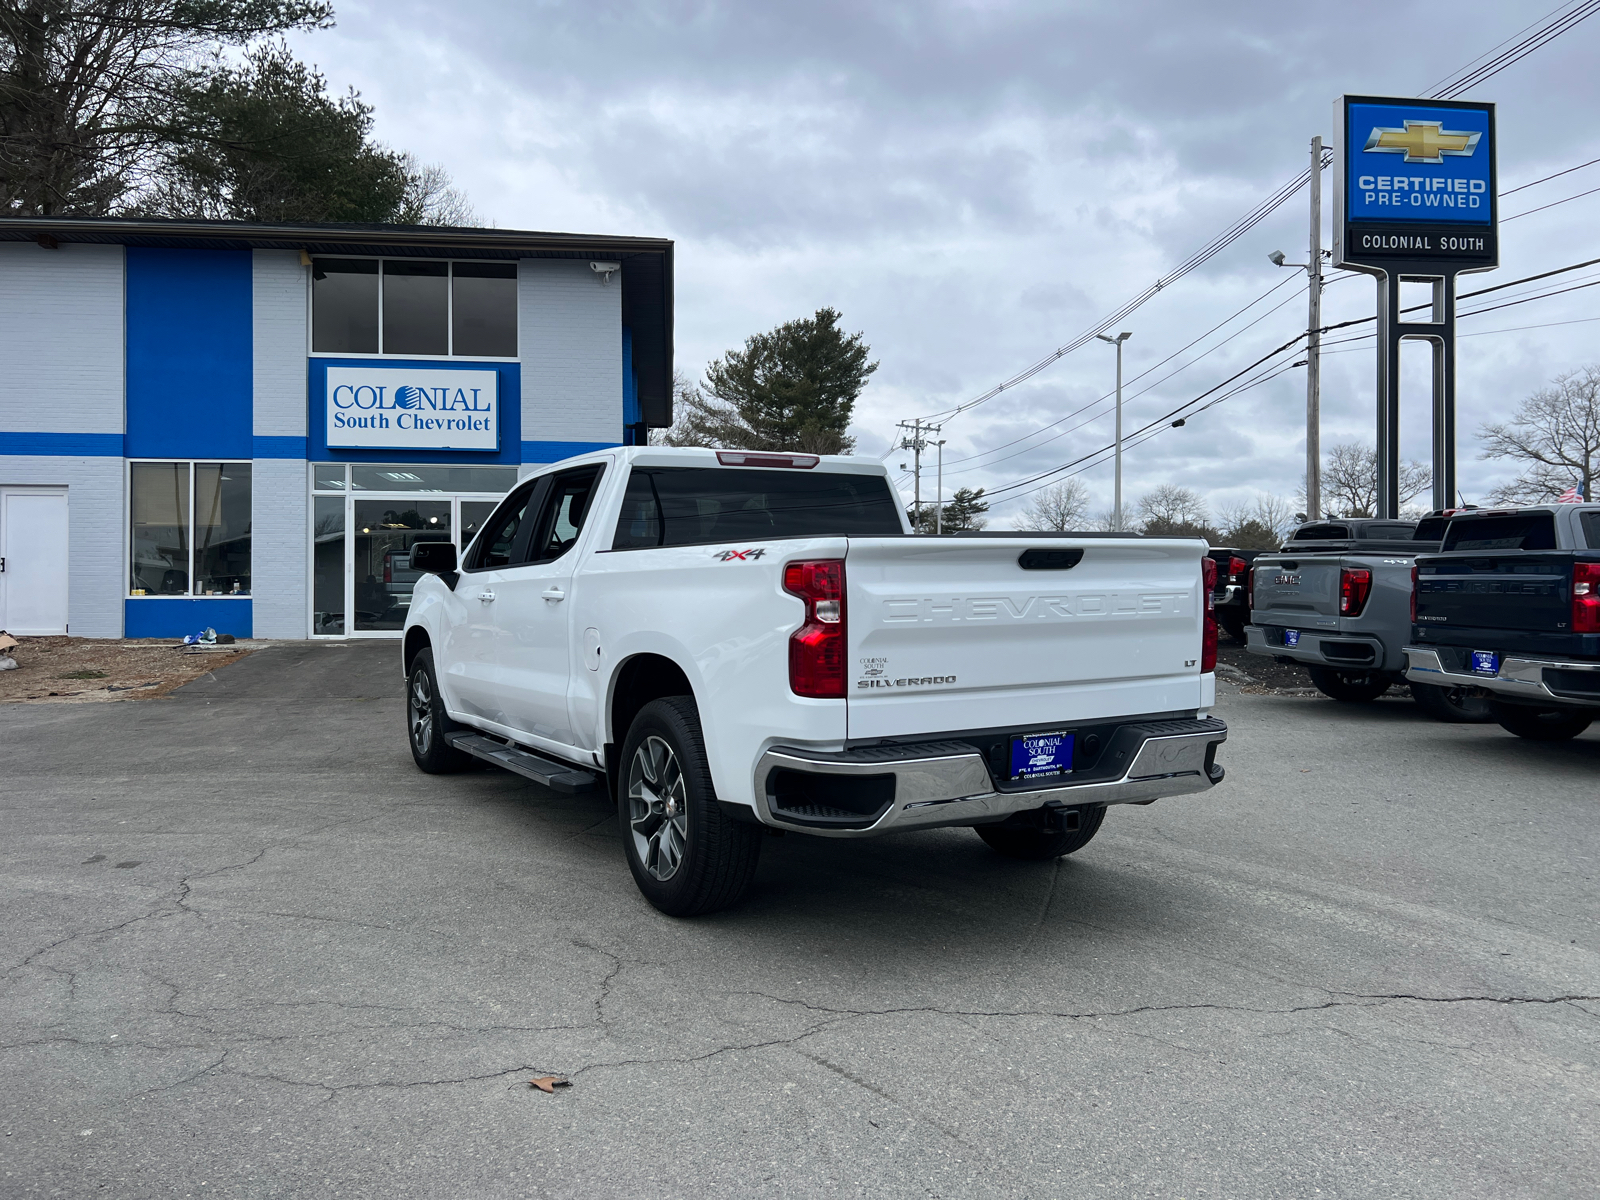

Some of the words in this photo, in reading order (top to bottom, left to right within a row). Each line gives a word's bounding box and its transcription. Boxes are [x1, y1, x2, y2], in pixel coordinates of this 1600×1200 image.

[1358, 175, 1486, 193] CERTIFIED
[1365, 192, 1480, 208] PRE-OWNED
[1362, 235, 1431, 249] COLONIAL
[1440, 237, 1484, 251] SOUTH
[333, 385, 491, 412] COLONIAL
[334, 412, 390, 429] South
[396, 413, 491, 431] Chevrolet
[1274, 575, 1301, 585] GMC
[1421, 582, 1556, 595] CHEVROLET
[882, 591, 1190, 622] CHEVROLET
[1184, 659, 1197, 667] LT
[857, 675, 957, 689] SILVERADO
[1023, 738, 1062, 748] COLONIAL
[1029, 746, 1055, 756] SOUTH
